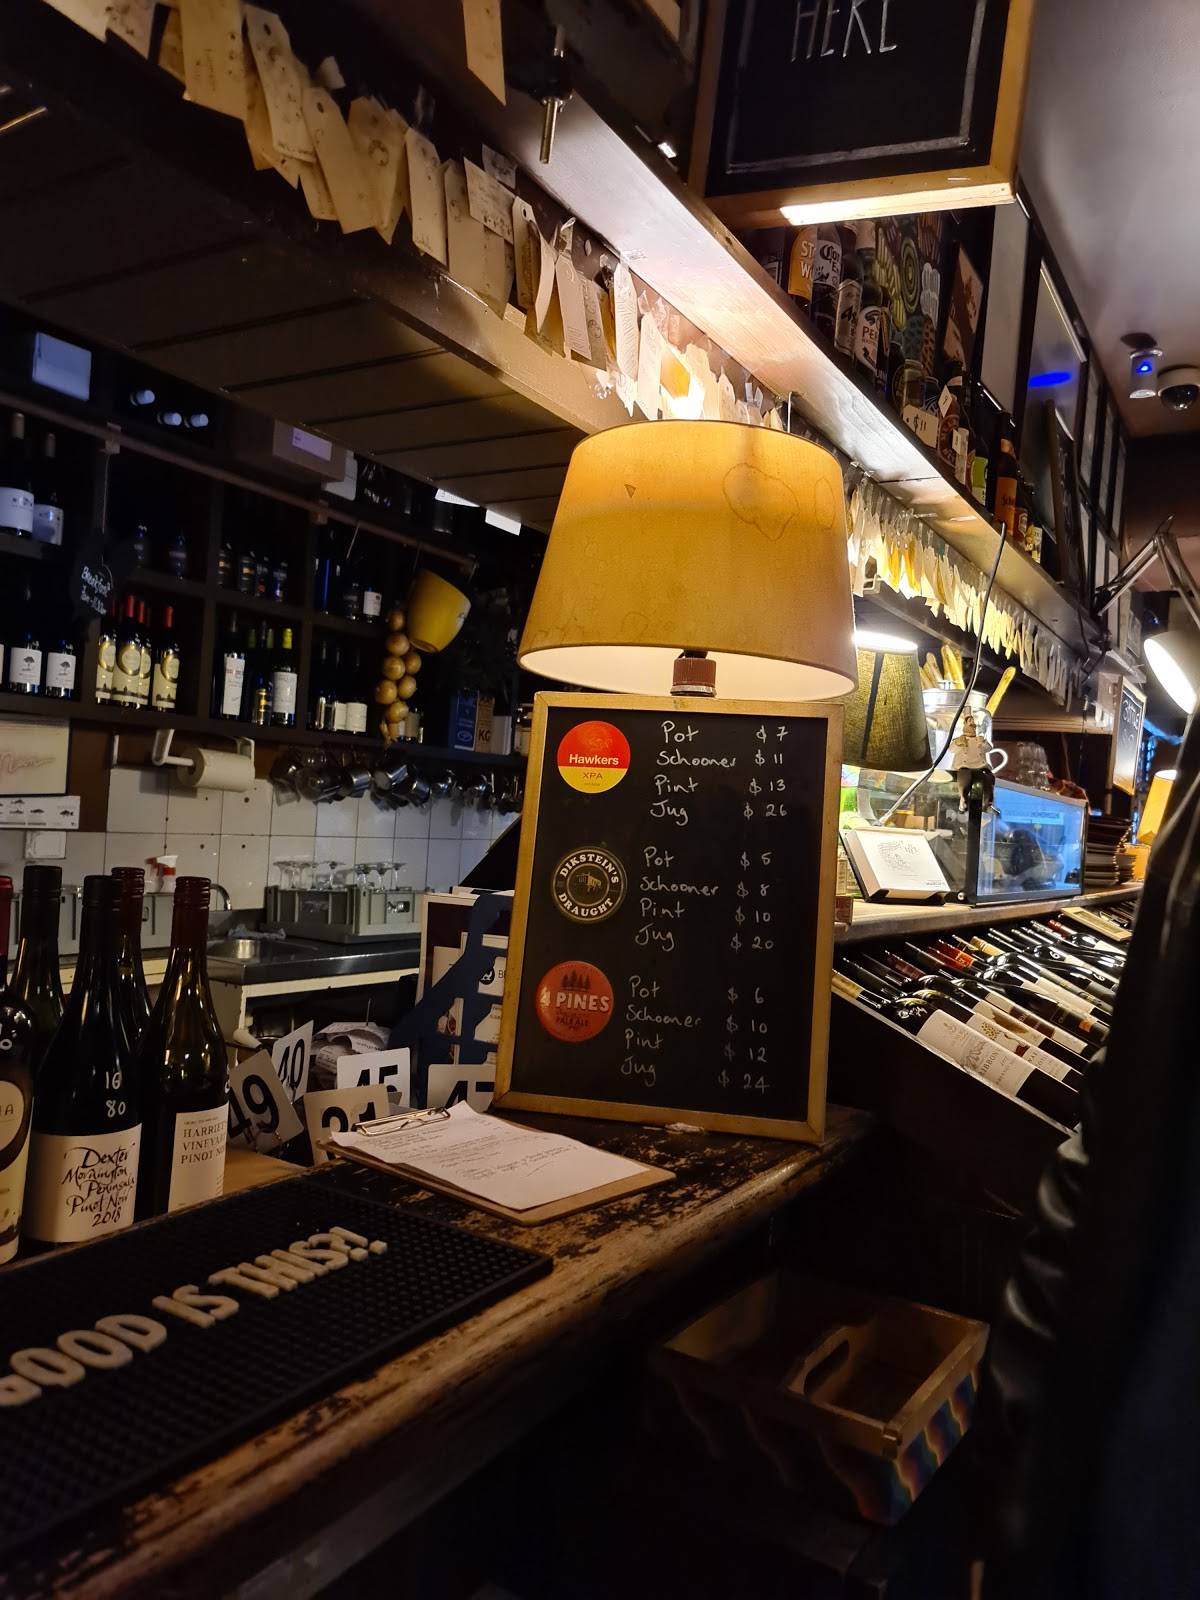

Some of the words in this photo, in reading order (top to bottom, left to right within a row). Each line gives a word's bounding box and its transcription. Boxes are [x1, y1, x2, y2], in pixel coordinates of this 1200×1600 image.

[661, 720, 699, 743] Pot
[776, 726, 789, 741] 7
[568, 753, 619, 765] Hawkers
[656, 750, 736, 768] Schooner
[774, 753, 783, 764] 11
[583, 772, 603, 780] XPA
[654, 775, 699, 795] Pint
[769, 779, 786, 792] 13
[650, 800, 689, 826] Jug
[766, 804, 788, 818] 26
[644, 846, 674, 868] Pot
[761, 853, 772, 866] 5
[560, 854, 619, 884] DIKSTEIN'S
[639, 876, 719, 897] Schooner
[760, 883, 770, 897] 8
[559, 893, 613, 917] DRAUGHT
[640, 898, 685, 919] Pint
[755, 910, 771, 923] 10
[635, 923, 675, 952] Jug
[751, 936, 774, 950] 20
[628, 975, 662, 999] Pot
[754, 988, 764, 1004] 6
[556, 992, 610, 1012] PINES
[626, 1005, 703, 1028] Schooner
[751, 1019, 768, 1034] 10
[624, 1029, 663, 1050] Pint
[105, 1071, 122, 1090] 16
[620, 1057, 656, 1087] Jug
[443, 1081, 495, 1109] 4
[105, 1100, 127, 1118] 80
[227, 1074, 280, 1144] 49
[72, 1147, 129, 1168] Dexter
[181, 1150, 213, 1165] PINOT
[92, 1206, 121, 1227] 2018
[151, 1283, 240, 1329] IS
